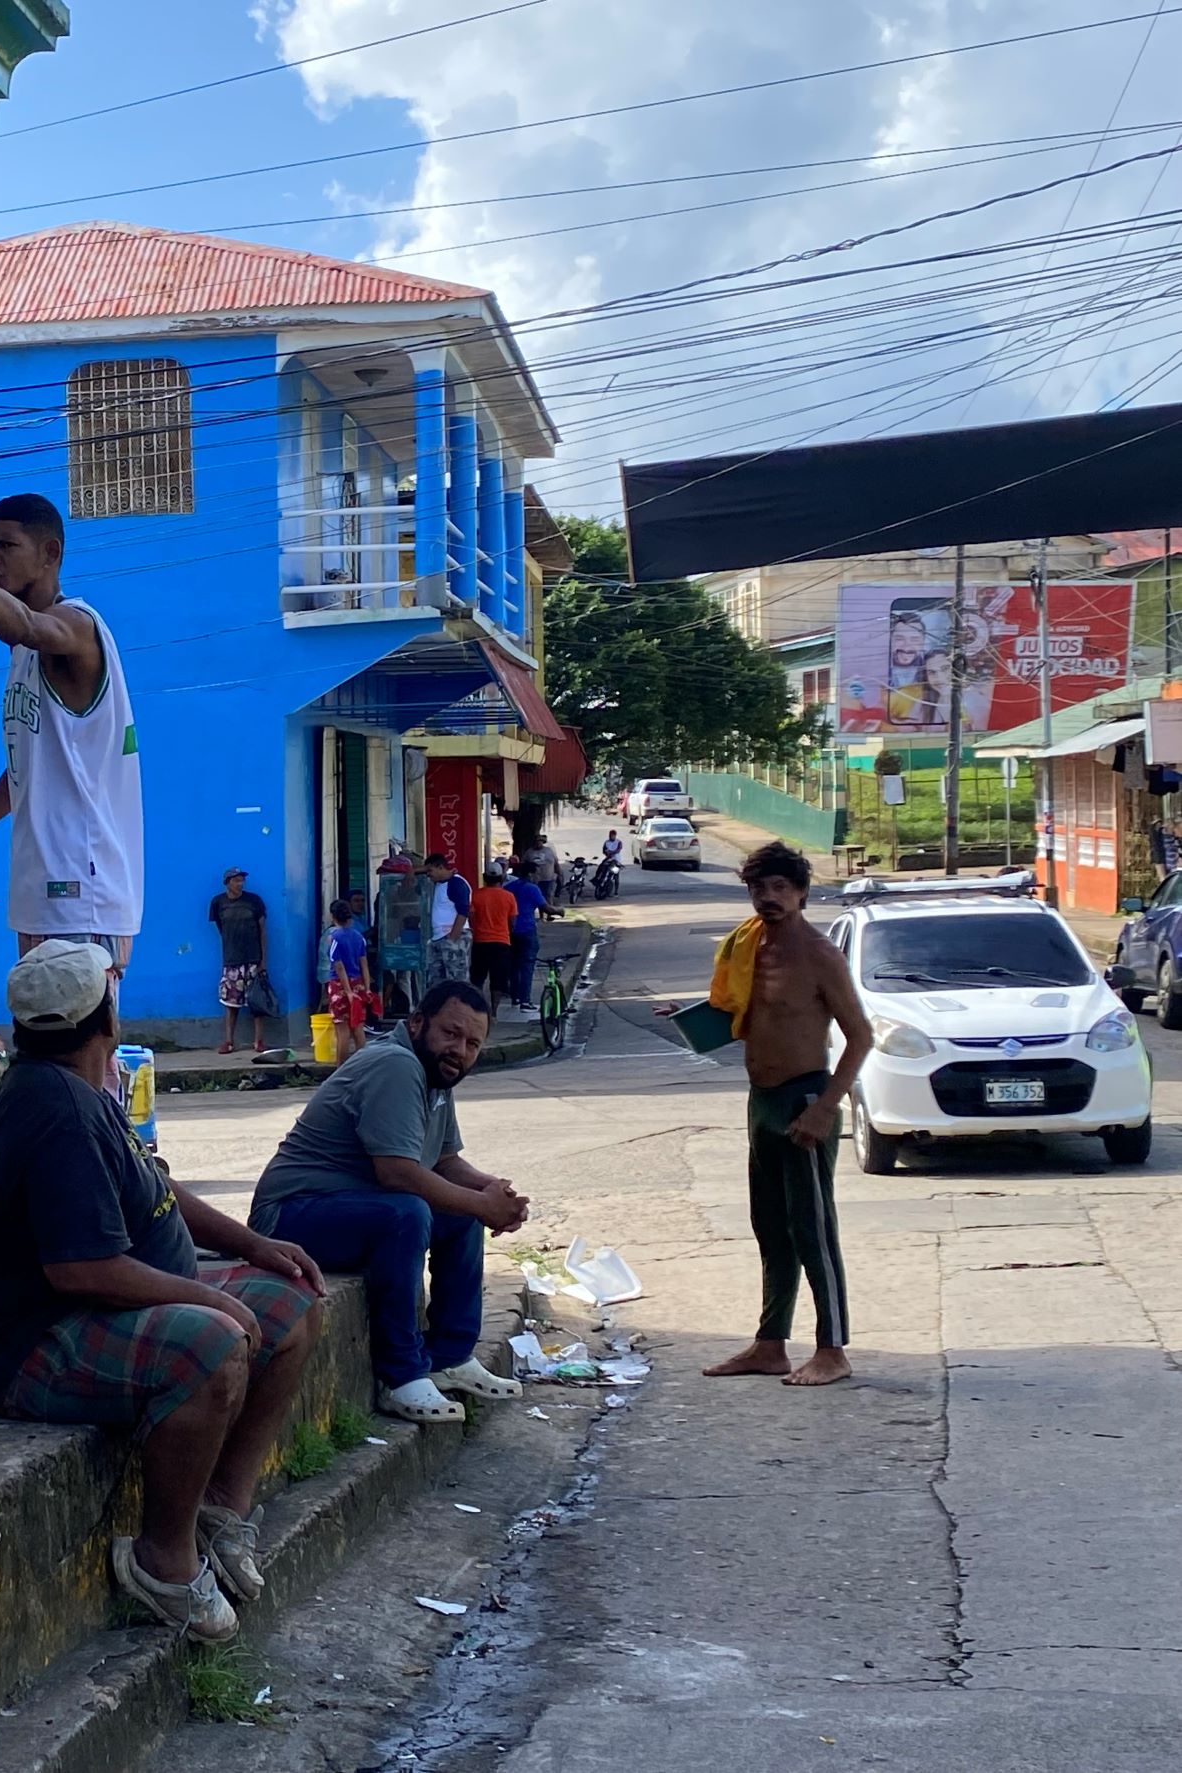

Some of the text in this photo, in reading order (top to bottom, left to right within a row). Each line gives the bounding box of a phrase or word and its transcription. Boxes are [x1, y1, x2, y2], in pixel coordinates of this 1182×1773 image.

[1019, 639, 1079, 654] JUTOS
[998, 1085, 1019, 1099] 356
[1022, 1085, 1044, 1099] 352
